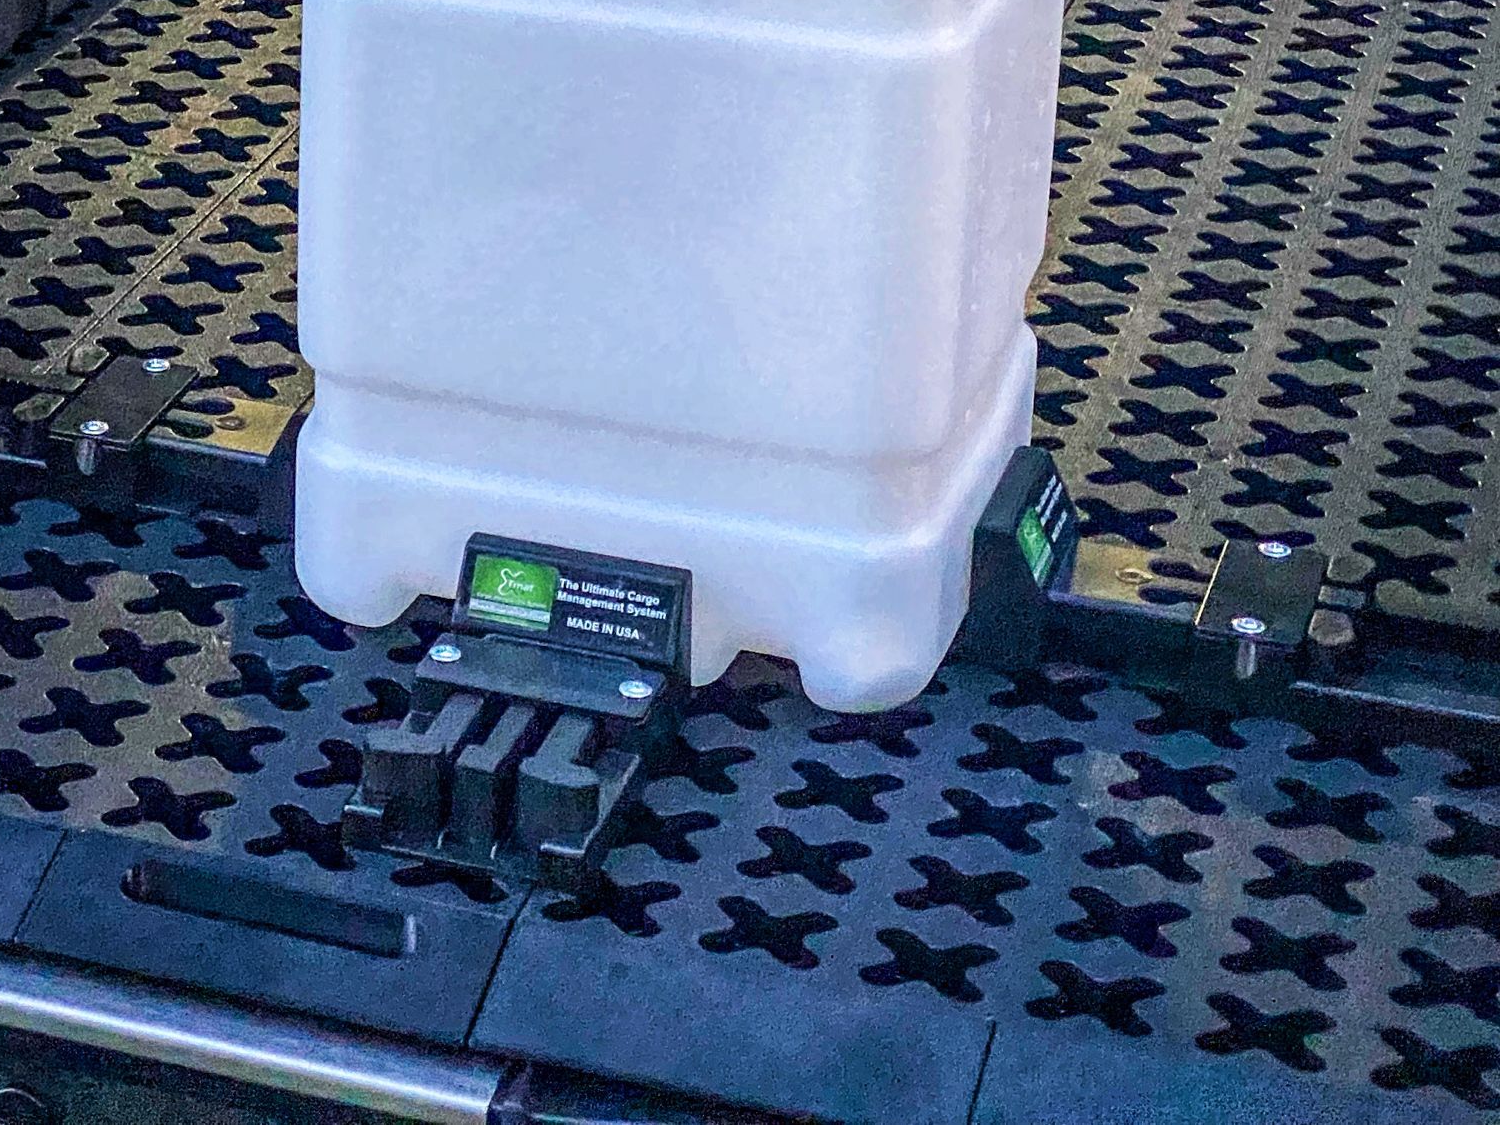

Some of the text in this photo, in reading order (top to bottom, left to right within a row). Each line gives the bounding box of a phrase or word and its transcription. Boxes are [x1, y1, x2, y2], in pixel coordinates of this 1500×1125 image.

[557, 590, 625, 613] Management
[626, 603, 667, 620] System
[560, 578, 660, 606] The Ultimate Cargo
[566, 617, 640, 640] MADE IN USA
